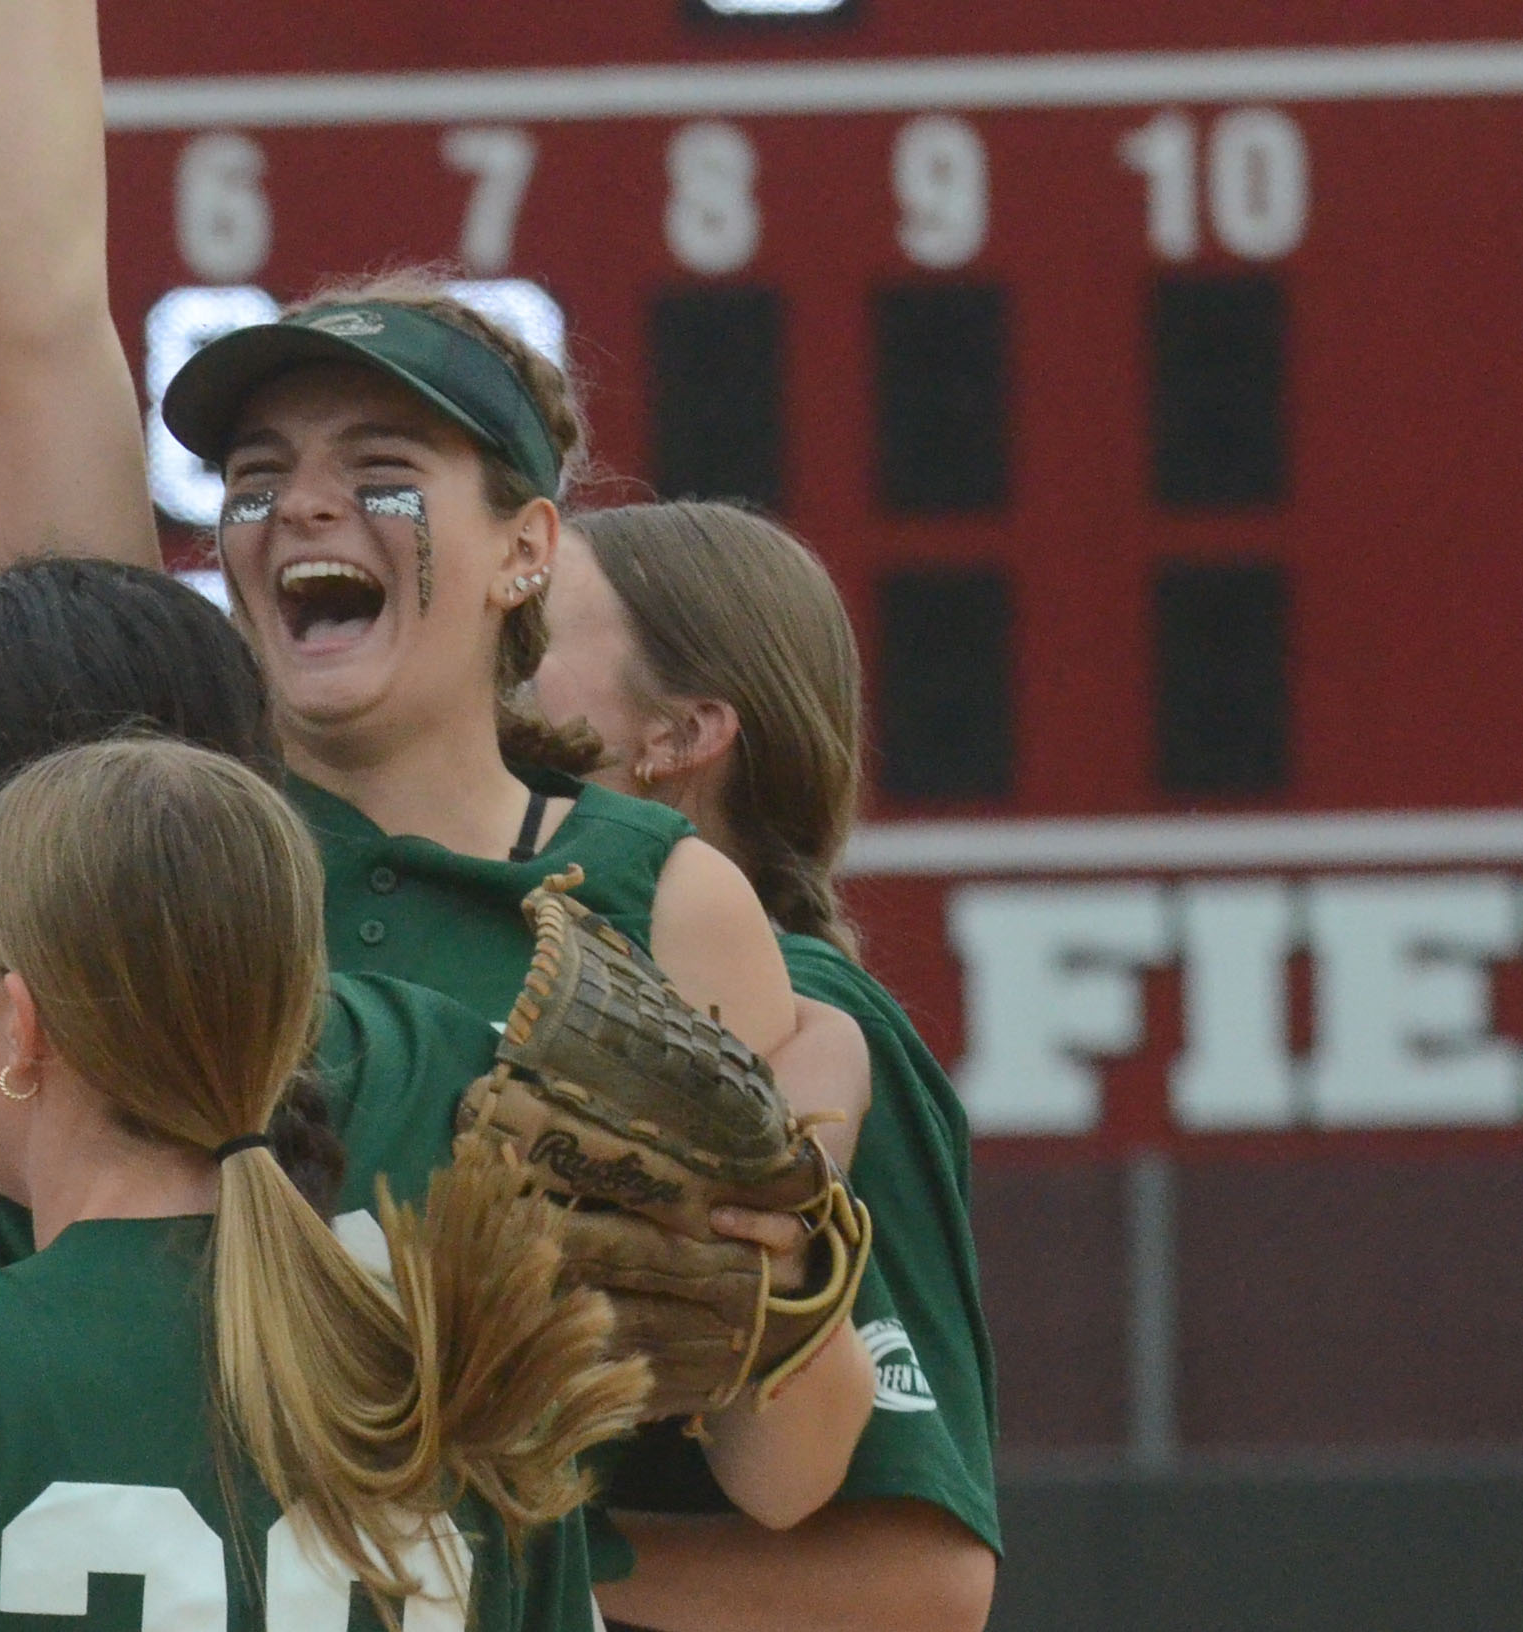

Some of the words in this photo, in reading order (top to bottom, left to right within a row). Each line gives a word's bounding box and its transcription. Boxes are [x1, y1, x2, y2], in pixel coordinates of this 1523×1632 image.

[175, 130, 275, 283] 6
[441, 126, 537, 276] 7
[665, 120, 762, 274] 8
[891, 112, 990, 270] 9
[1118, 106, 1311, 264] 10
